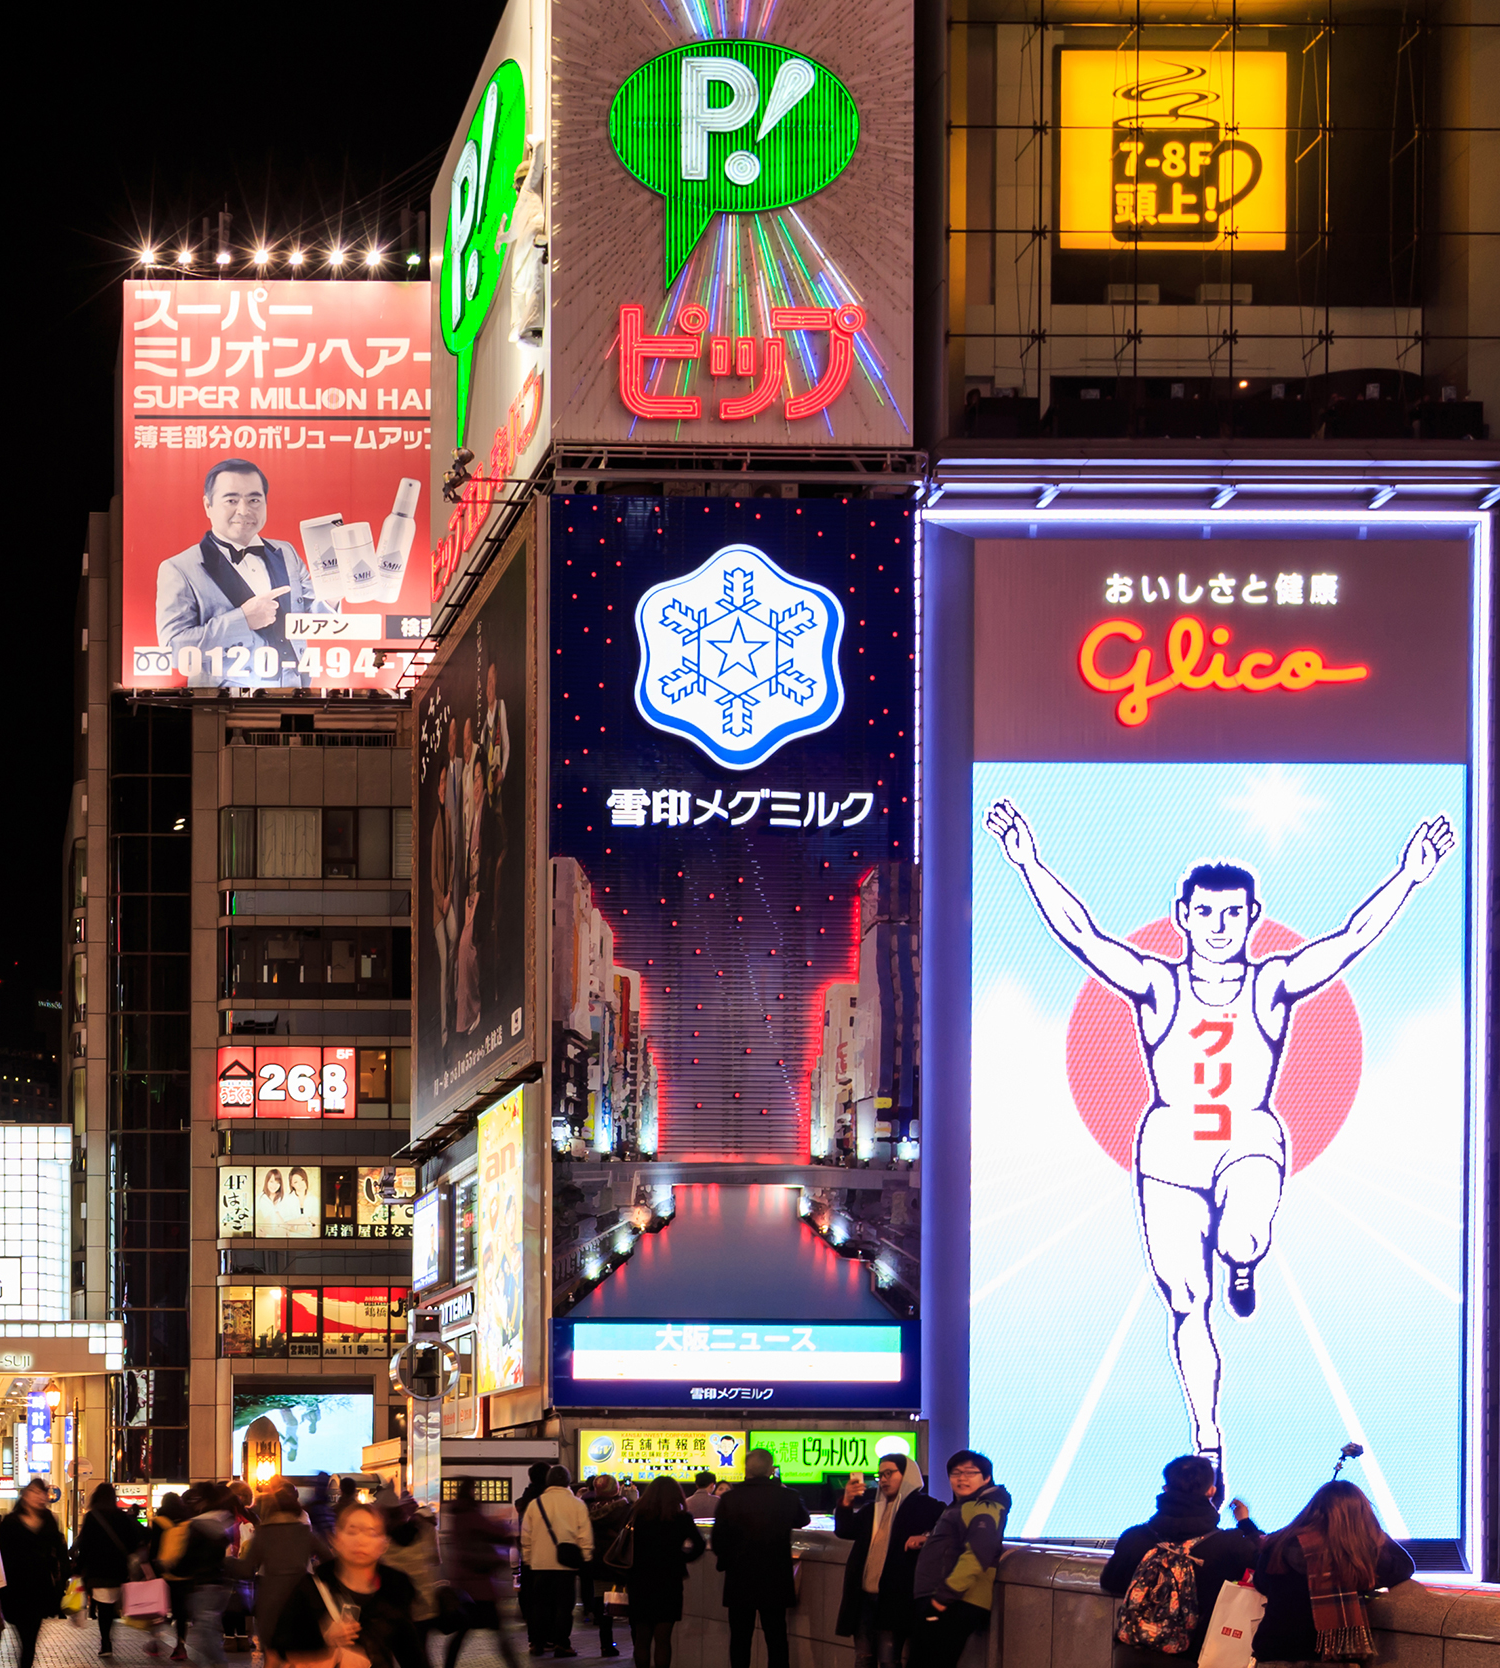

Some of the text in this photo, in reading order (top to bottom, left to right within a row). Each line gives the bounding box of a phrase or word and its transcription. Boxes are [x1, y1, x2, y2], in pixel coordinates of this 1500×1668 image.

[681, 56, 816, 186] P!
[1119, 141, 1213, 178] 7-8F
[1114, 182, 1218, 225] 頭上!
[134, 287, 313, 331] スーパー
[619, 303, 866, 420] ピップ
[133, 385, 240, 409] SUPER
[251, 387, 367, 411] MILLION
[353, 570, 372, 581] SMH
[382, 560, 402, 571] SMH
[1104, 572, 1339, 605] おいしさと健康
[292, 618, 349, 635] ルアン
[1078, 616, 1369, 727] Glico
[606, 788, 874, 827] 雪印メグミルク
[336, 1049, 353, 1059] 5F
[1188, 1013, 1237, 1141] グリコ
[485, 1142, 516, 1183] an
[223, 1175, 247, 1190] 4F
[223, 1192, 249, 1230] はなこ
[434, 1292, 472, 1326] OTTERIA
[655, 1324, 817, 1351] 大阪ニュース
[690, 1387, 774, 1400] 雪印メグミルク
[621, 1439, 706, 1451] 店舗情報館
[803, 1436, 869, 1466] ピタットハウス
